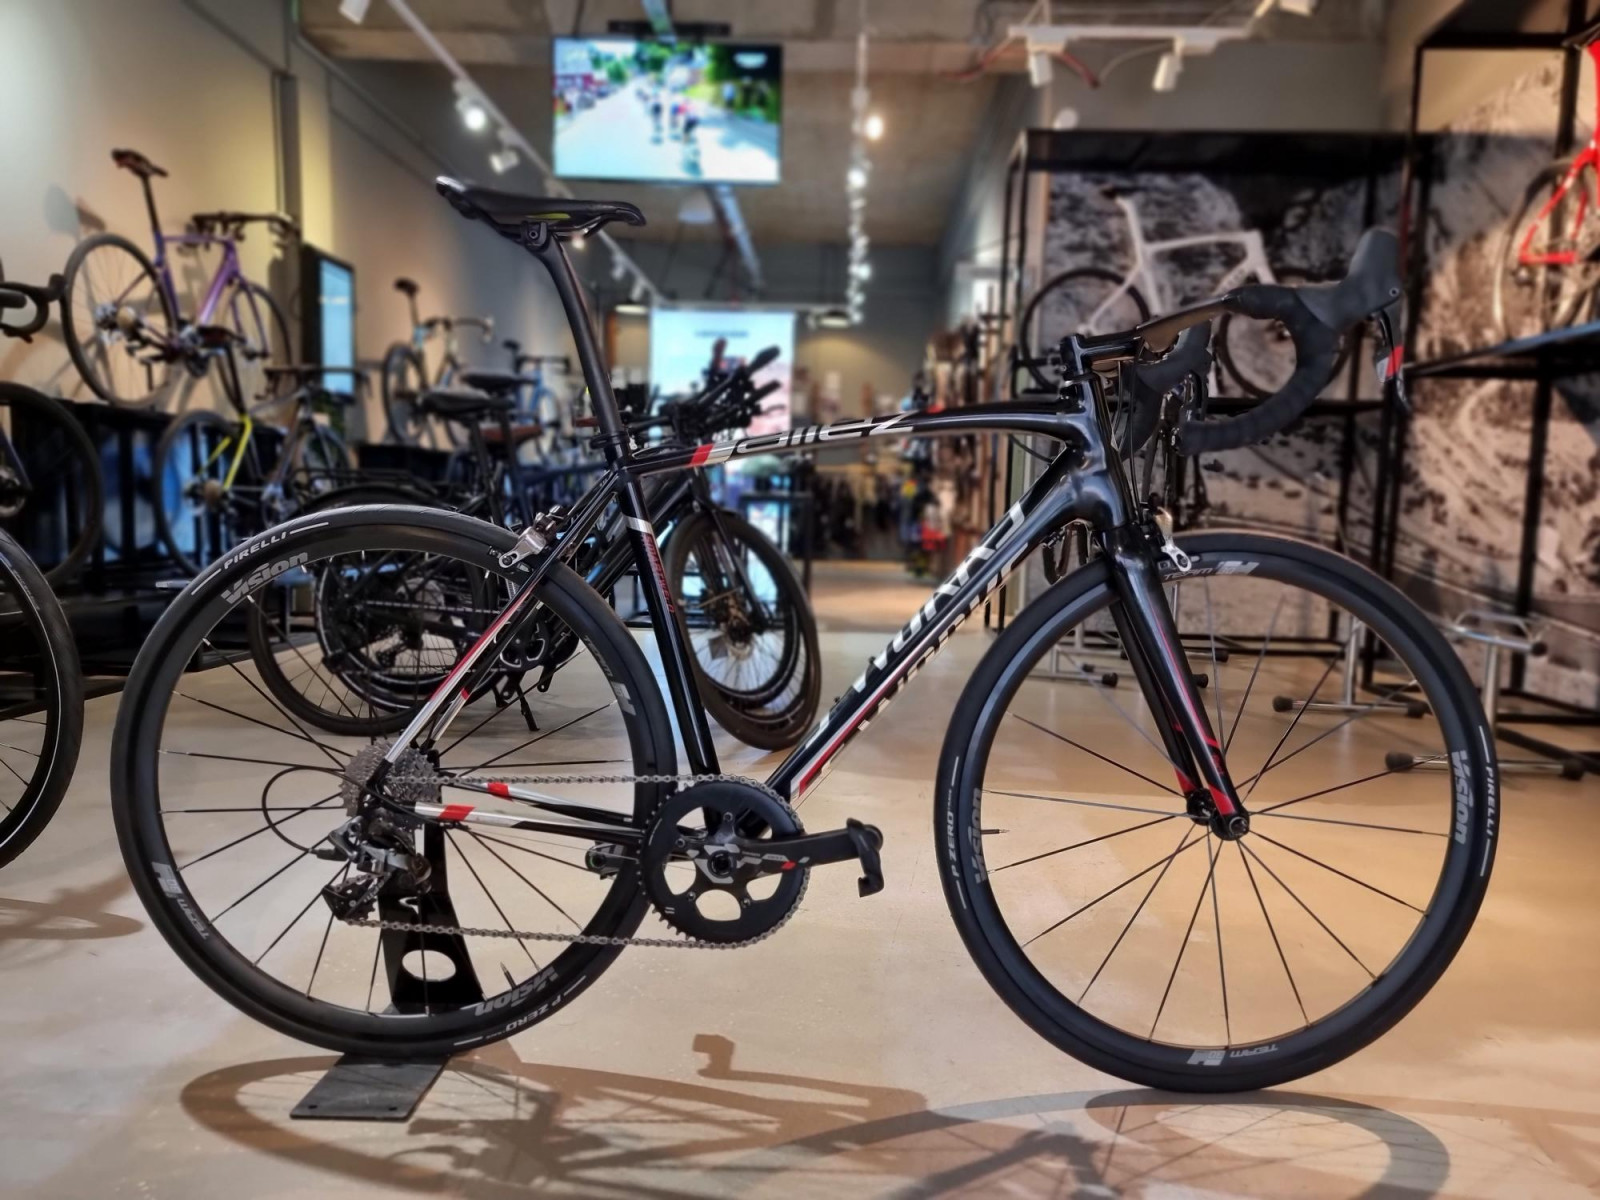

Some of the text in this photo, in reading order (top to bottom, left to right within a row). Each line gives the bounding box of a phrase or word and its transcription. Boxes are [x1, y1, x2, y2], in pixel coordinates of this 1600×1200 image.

[223, 530, 287, 570] PIRELLI
[1485, 766, 1495, 836] PIRELLI
[946, 811, 957, 862] ZERO
[951, 865, 960, 878] P
[505, 1003, 549, 1032] ZERO
